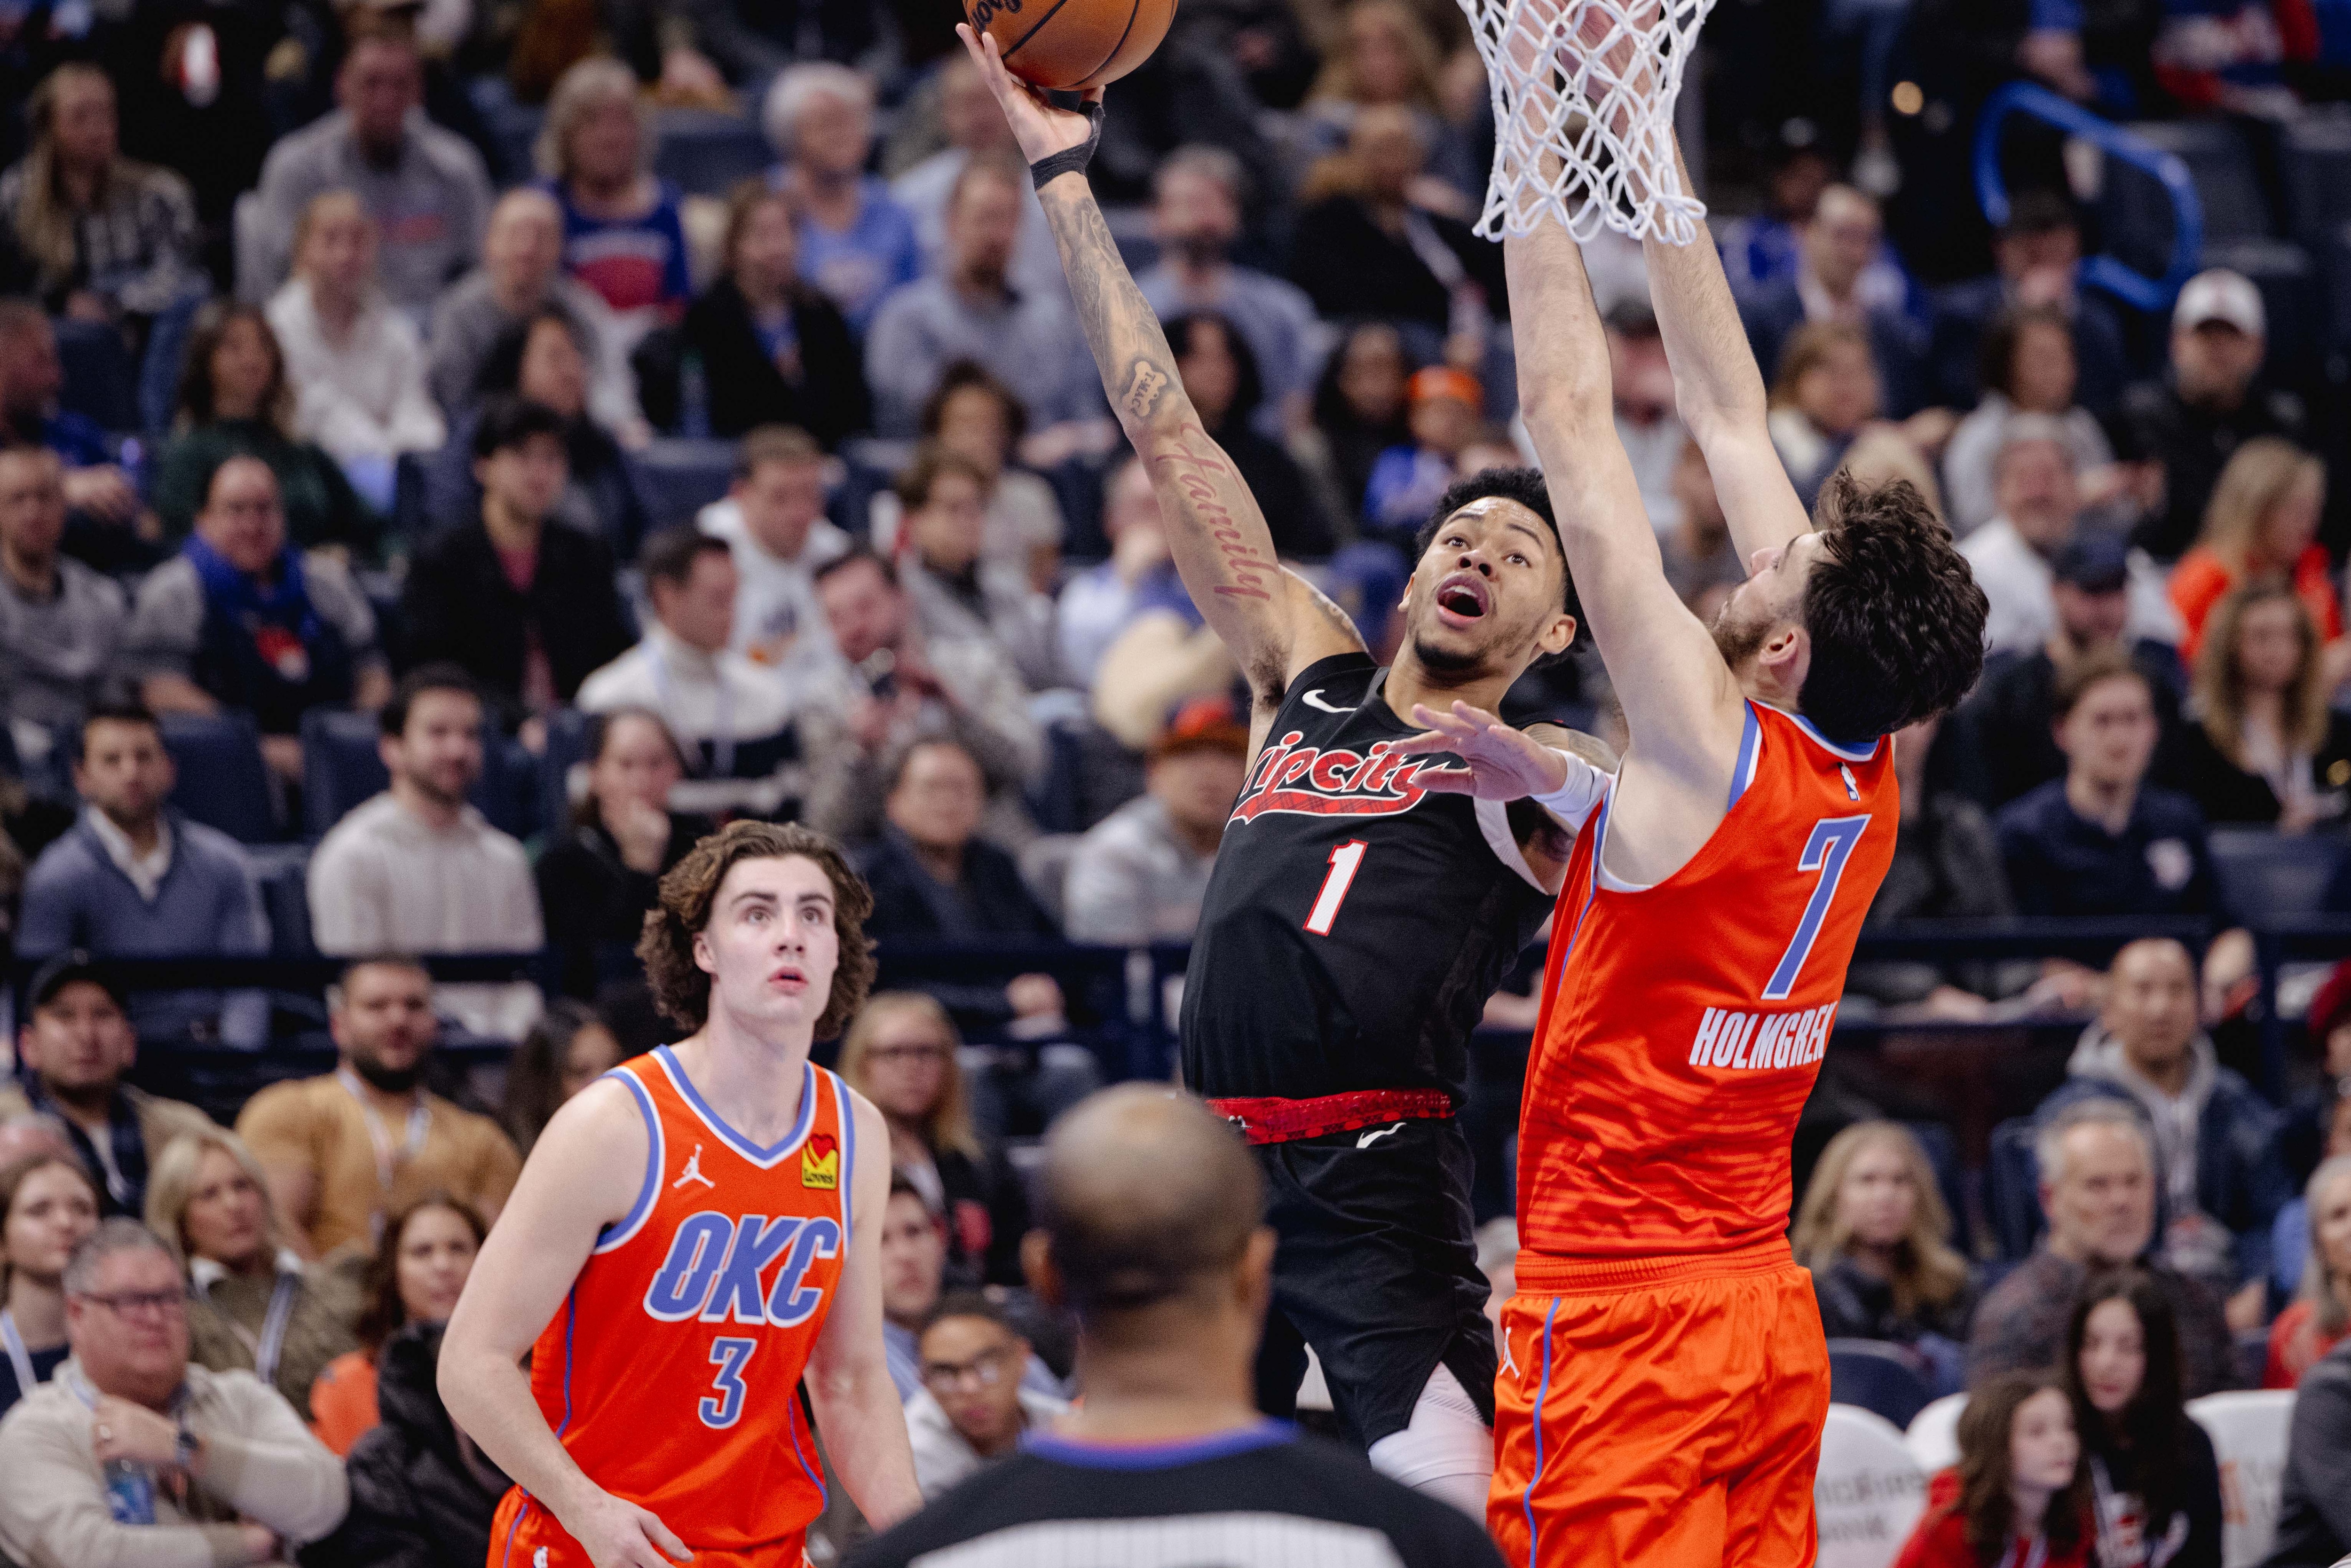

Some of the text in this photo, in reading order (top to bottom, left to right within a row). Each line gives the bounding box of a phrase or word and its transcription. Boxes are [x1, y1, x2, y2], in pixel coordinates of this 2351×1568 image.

[1302, 838, 1369, 937] 1
[1760, 813, 1872, 1000] 7
[643, 1210, 842, 1329] OKC
[698, 1336, 758, 1429] 3
